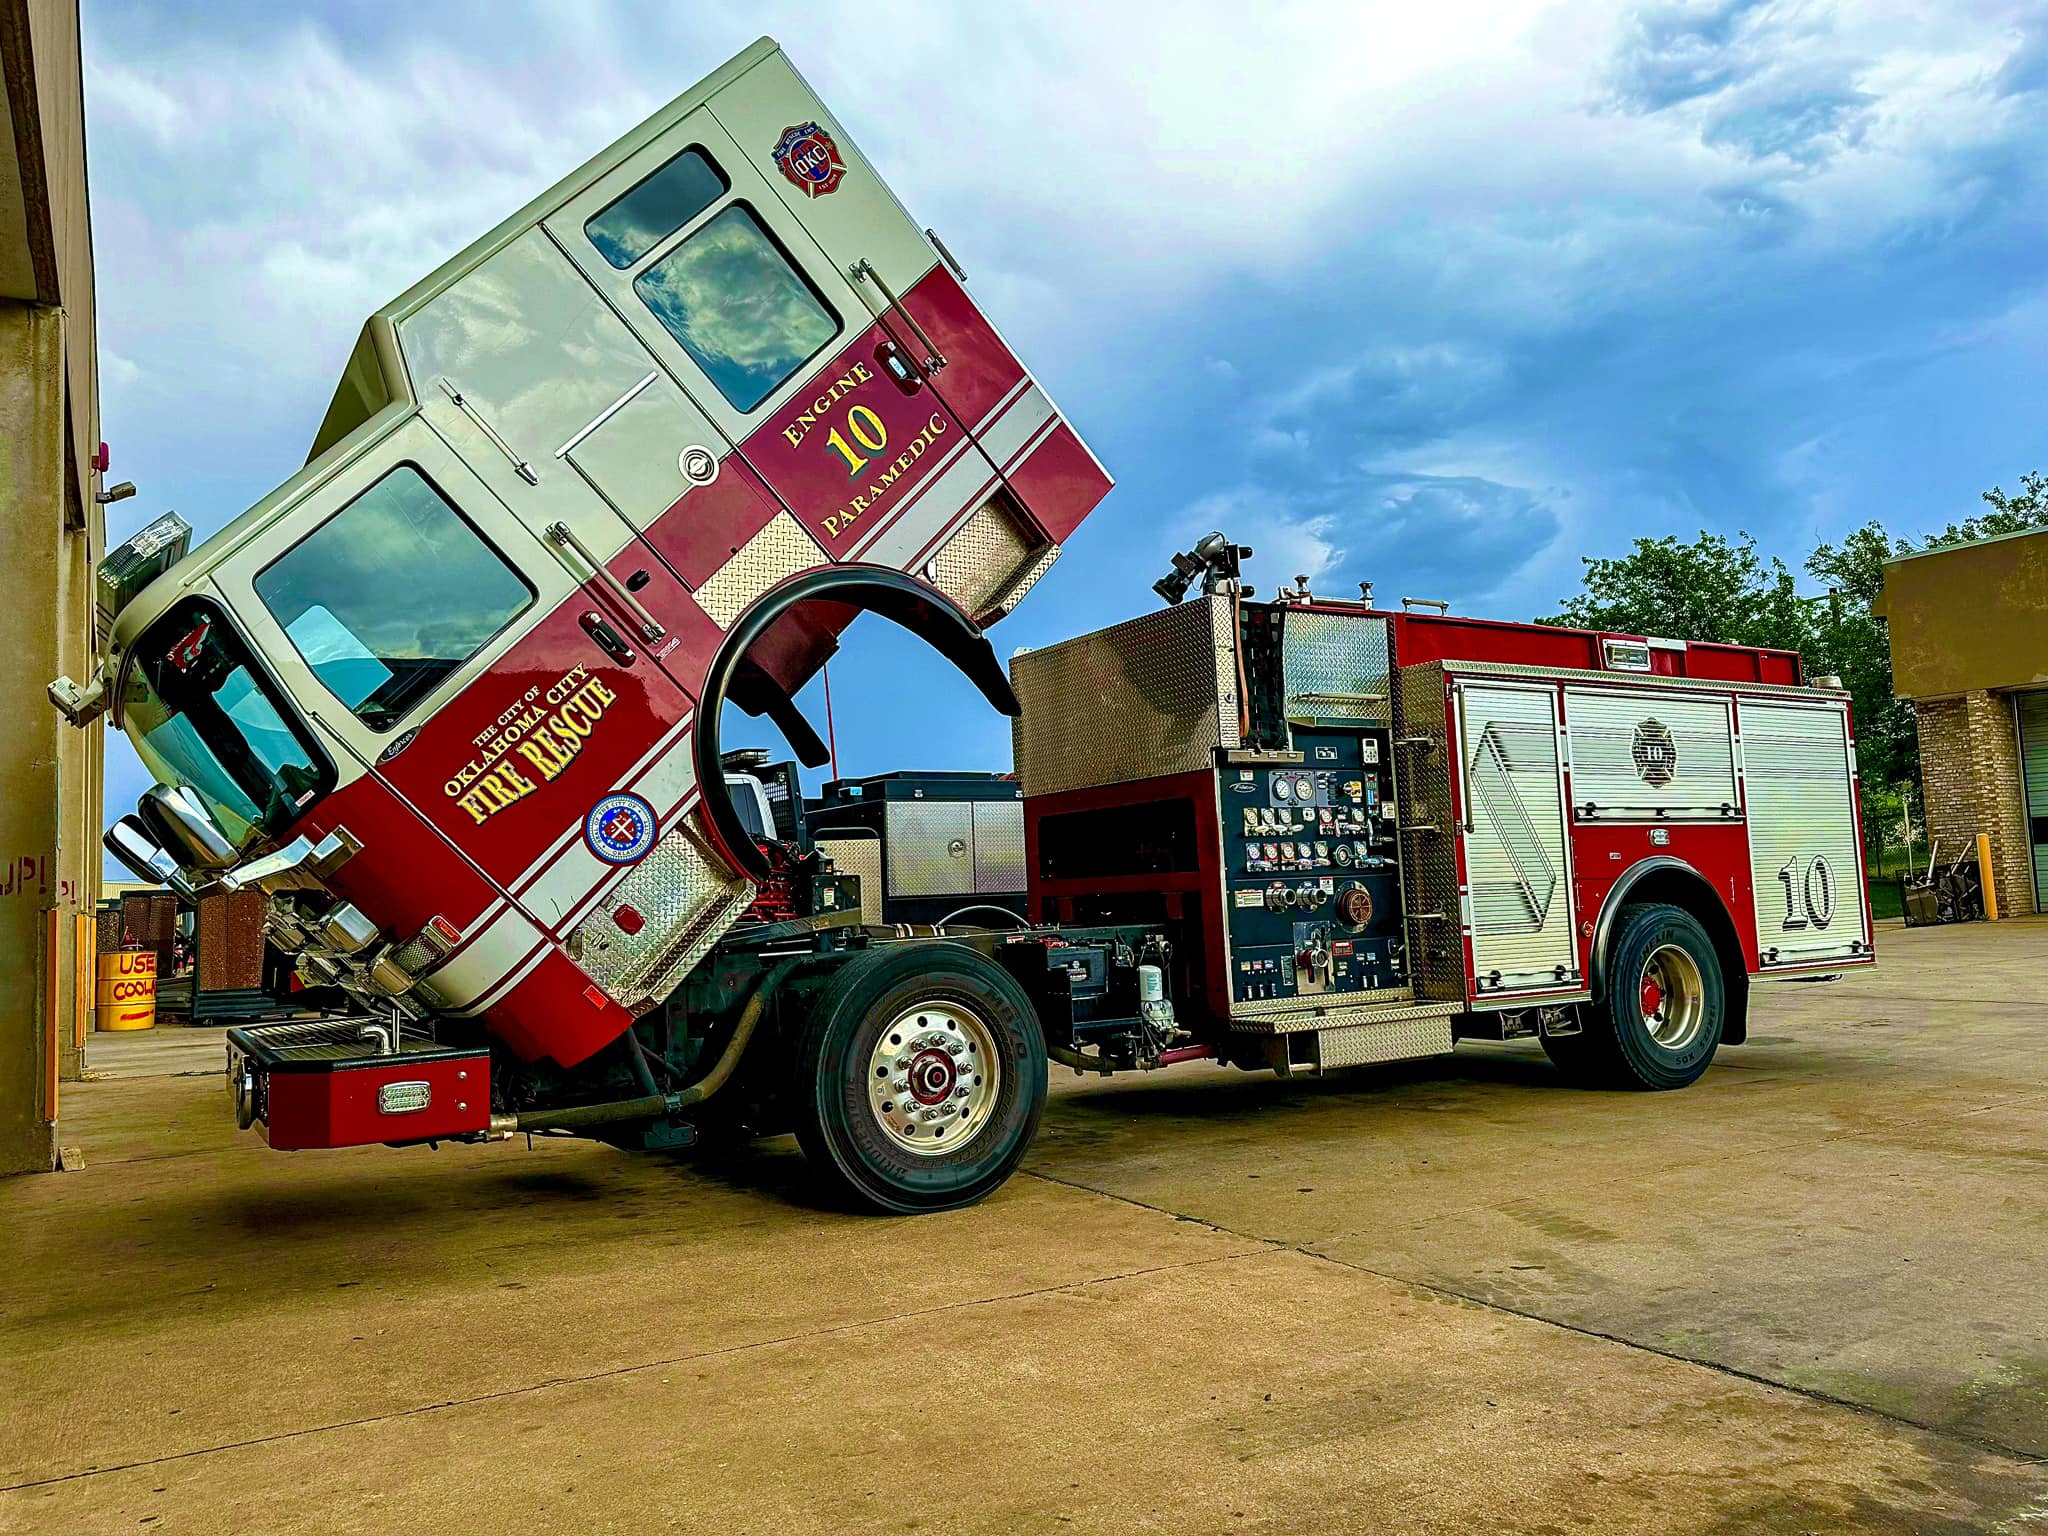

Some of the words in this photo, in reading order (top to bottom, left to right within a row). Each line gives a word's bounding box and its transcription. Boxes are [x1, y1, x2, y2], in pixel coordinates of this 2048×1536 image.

[795, 145, 827, 175] OKC
[782, 361, 874, 449] ENGINE
[826, 405, 888, 478] 10
[820, 412, 948, 539] PARAMEDIC
[387, 733, 413, 755] Enforcer
[444, 706, 548, 798] OKLAHOMA
[546, 662, 589, 706] CITY
[456, 759, 538, 825] FIRE
[516, 676, 617, 782] RESCUE
[472, 723, 498, 748] THE
[497, 699, 526, 725] CITY
[524, 685, 541, 702] OF
[1647, 746, 1663, 761] 10
[1778, 854, 1837, 932] 10
[120, 953, 156, 975] USE
